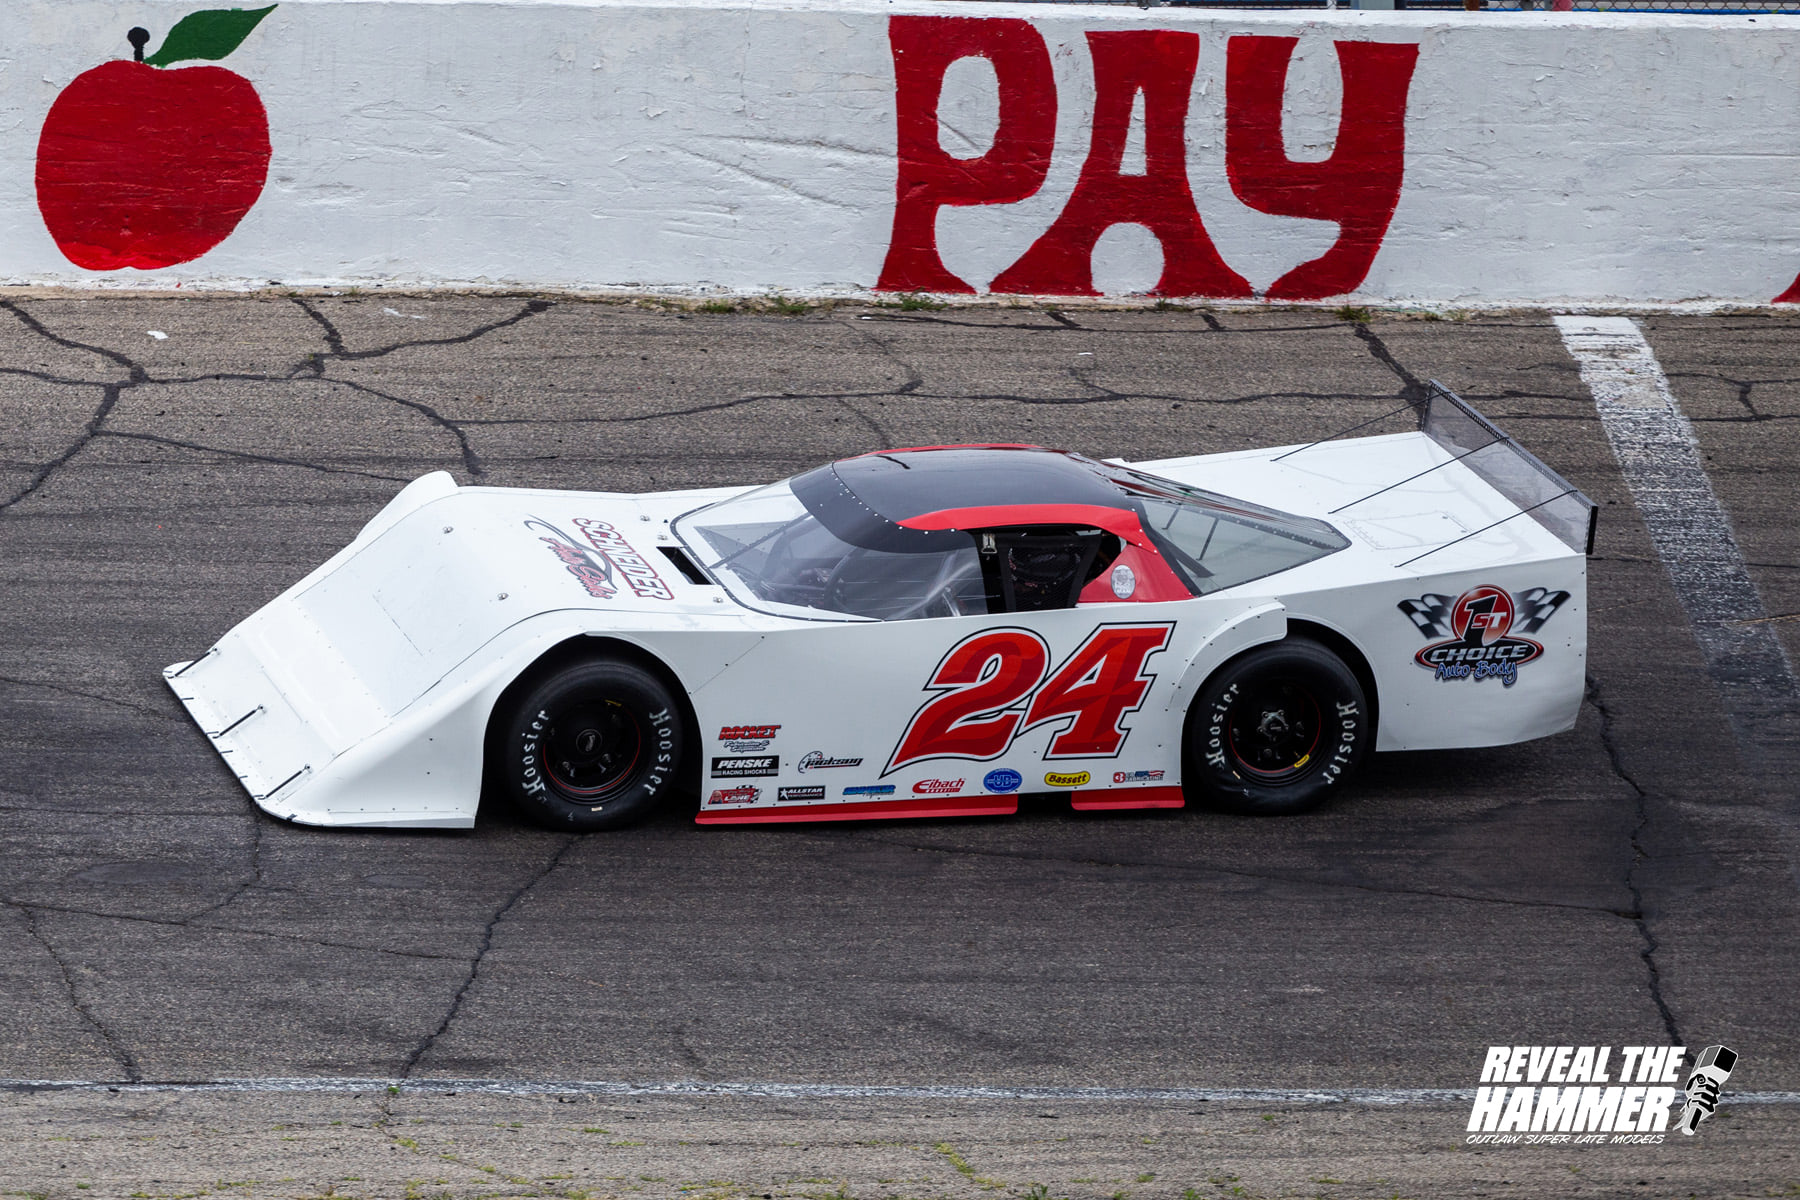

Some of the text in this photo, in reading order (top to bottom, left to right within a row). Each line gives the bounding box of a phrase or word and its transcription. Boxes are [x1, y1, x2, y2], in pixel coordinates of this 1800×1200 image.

[876, 16, 1420, 300] PAY
[572, 518, 674, 600] SCHNEIDER
[1430, 645, 1529, 662] CHOICE
[1435, 659, 1518, 687] Auto Body
[718, 725, 781, 740] ROCKET
[879, 620, 1177, 778] 24
[1205, 683, 1240, 767] Hoosier
[521, 709, 549, 796] Hoosier
[643, 708, 673, 796] Hoosier
[717, 758, 773, 769] PENSKE
[1048, 774, 1087, 784] Bassett
[1322, 701, 1360, 785] Hoosier
[912, 778, 966, 793] Eibach
